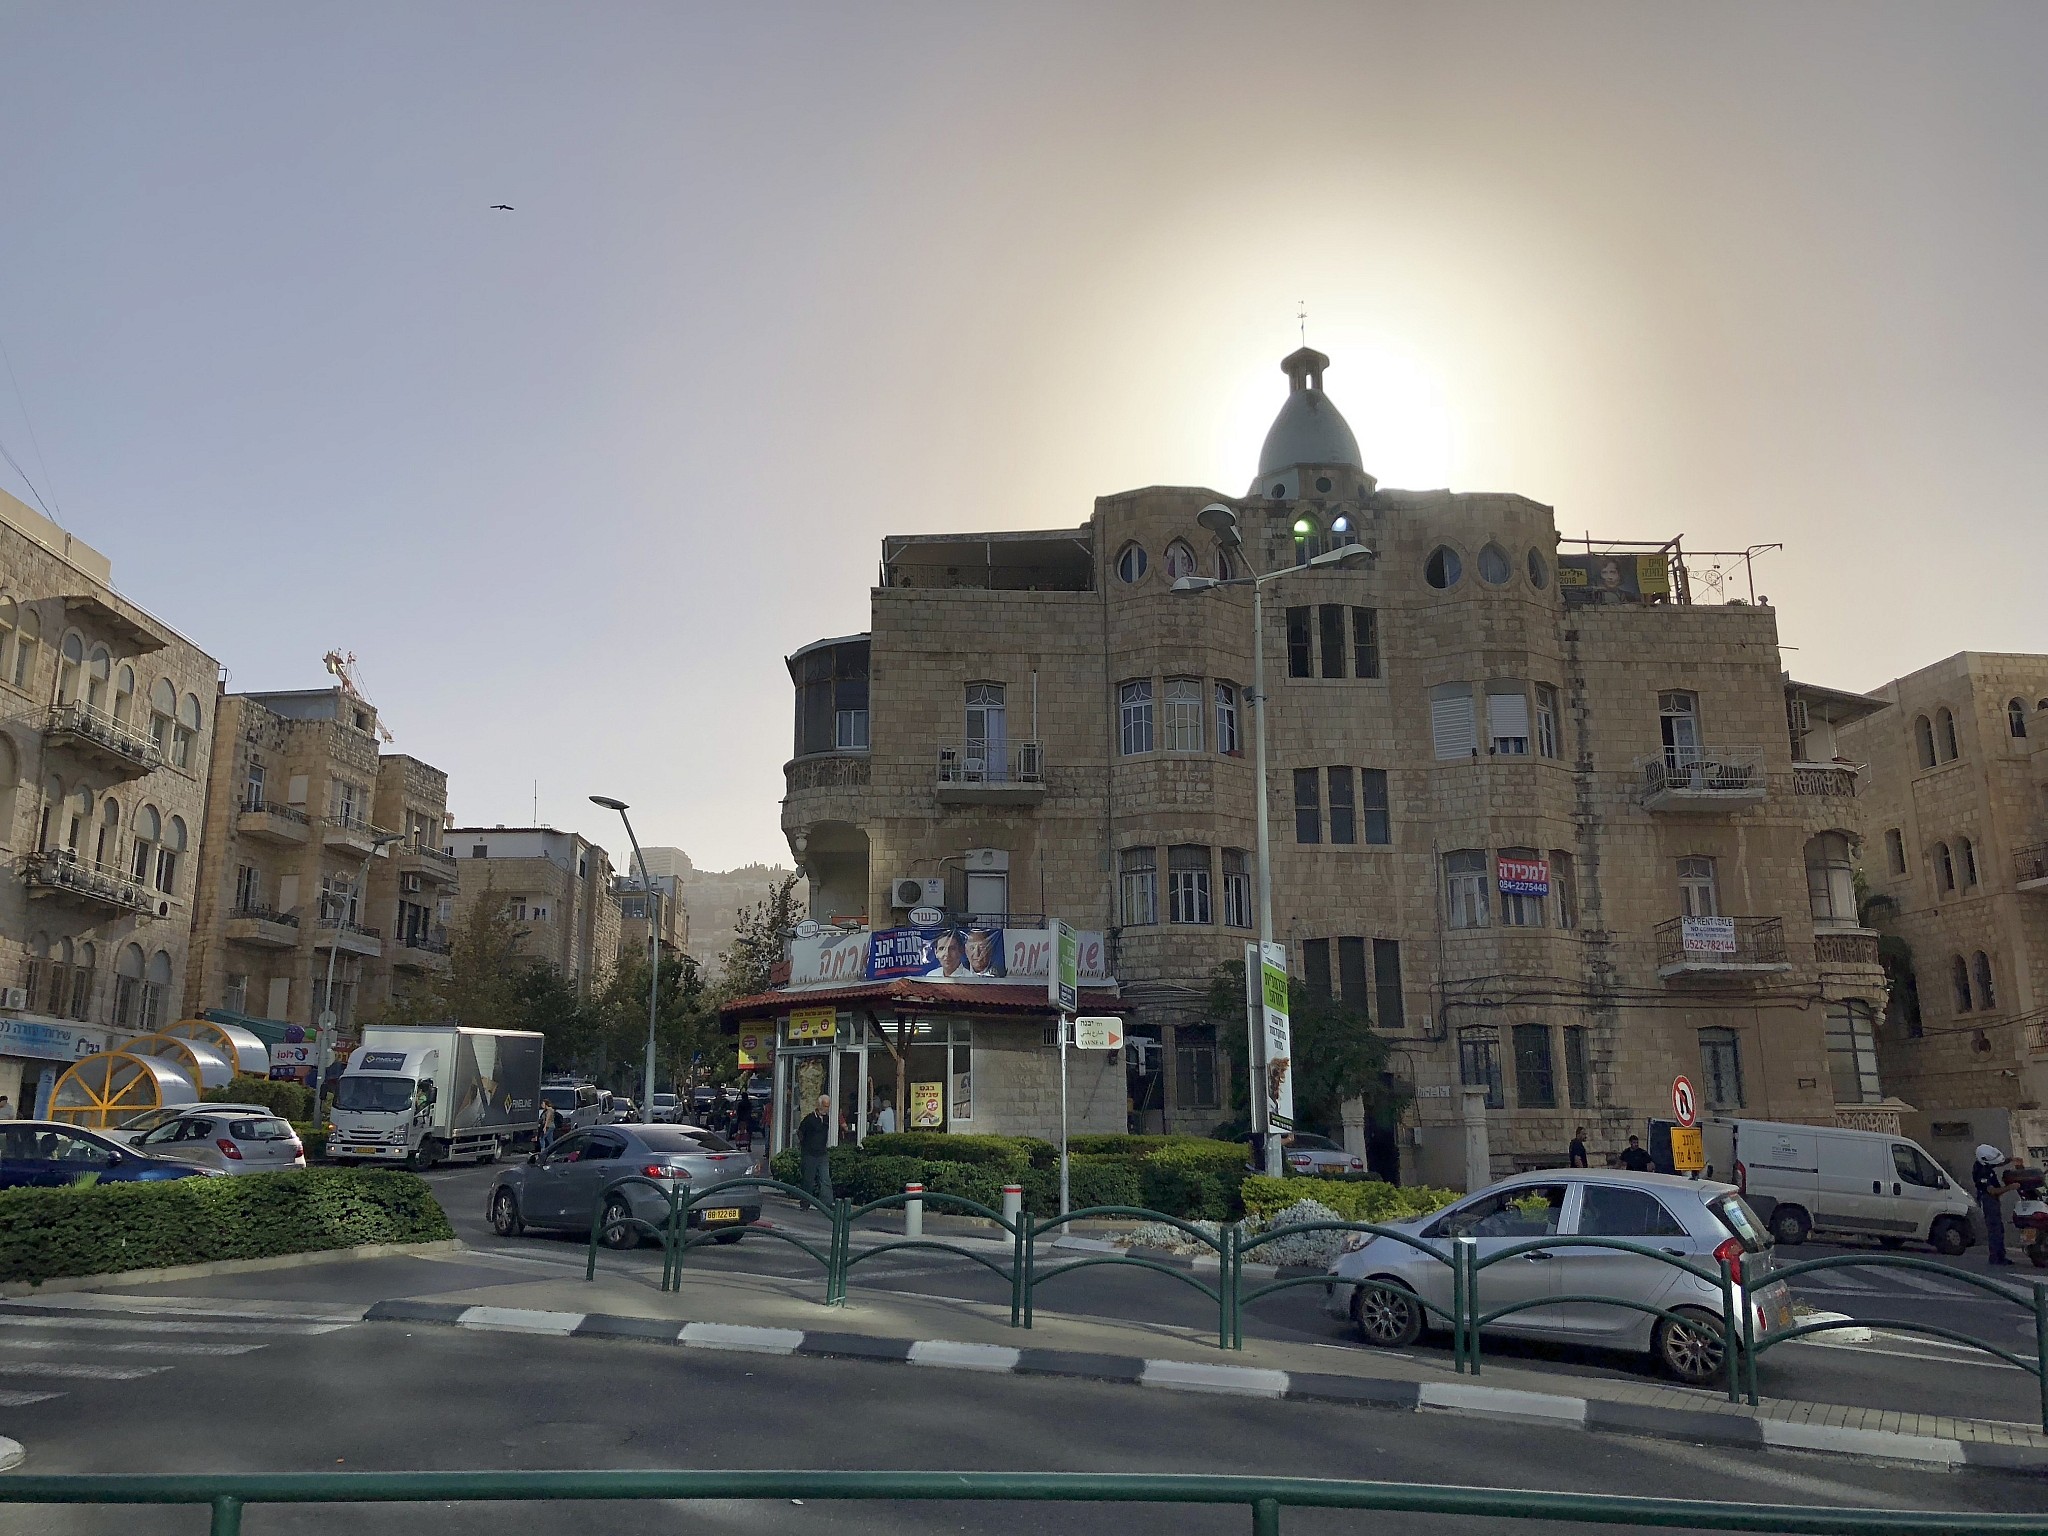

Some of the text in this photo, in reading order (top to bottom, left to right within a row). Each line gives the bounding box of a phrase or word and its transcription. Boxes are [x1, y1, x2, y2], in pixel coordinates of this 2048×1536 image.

[1559, 577, 1577, 585] 2018
[1499, 861, 1547, 881] למכירה
[1499, 880, 1548, 893] 054-2275448
[912, 912, 939, 922] כשר
[1683, 917, 1696, 925] FOR
[1697, 917, 1714, 926] RENT
[798, 924, 817, 935] כשר
[875, 938, 894, 957] יהב
[874, 956, 895, 969] חיפה
[277, 1049, 294, 1060] לוטו
